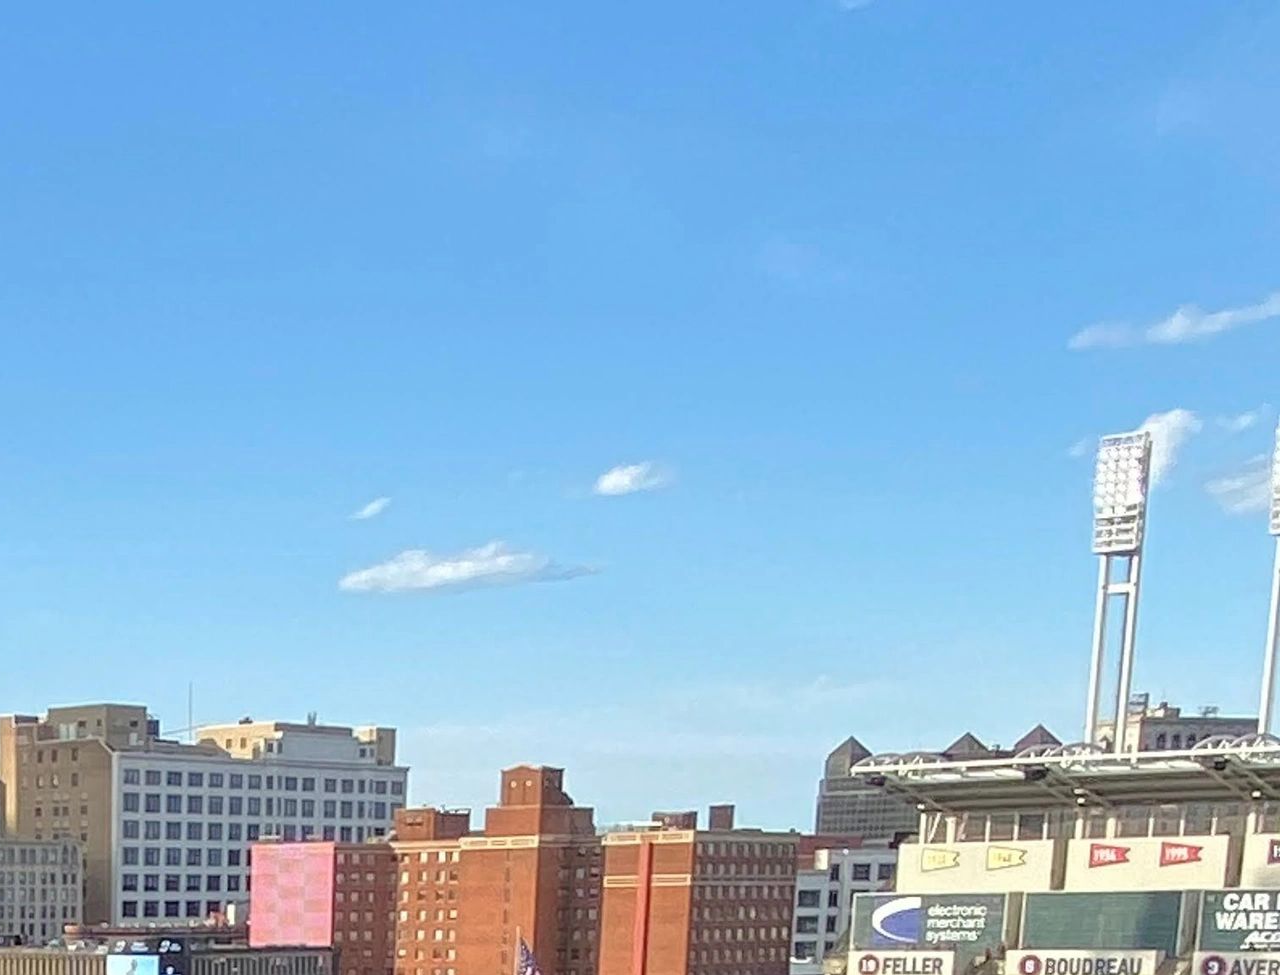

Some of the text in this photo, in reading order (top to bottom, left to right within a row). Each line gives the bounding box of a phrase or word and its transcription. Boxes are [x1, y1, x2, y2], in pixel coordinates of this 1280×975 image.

[1223, 893, 1270, 911] CAR
[928, 904, 987, 916] electronic
[927, 916, 985, 928] merchant
[926, 929, 979, 944] systems
[882, 957, 943, 975] FELLER
[1045, 958, 1142, 975] BOUDREAU
[1207, 961, 1219, 975] 3
